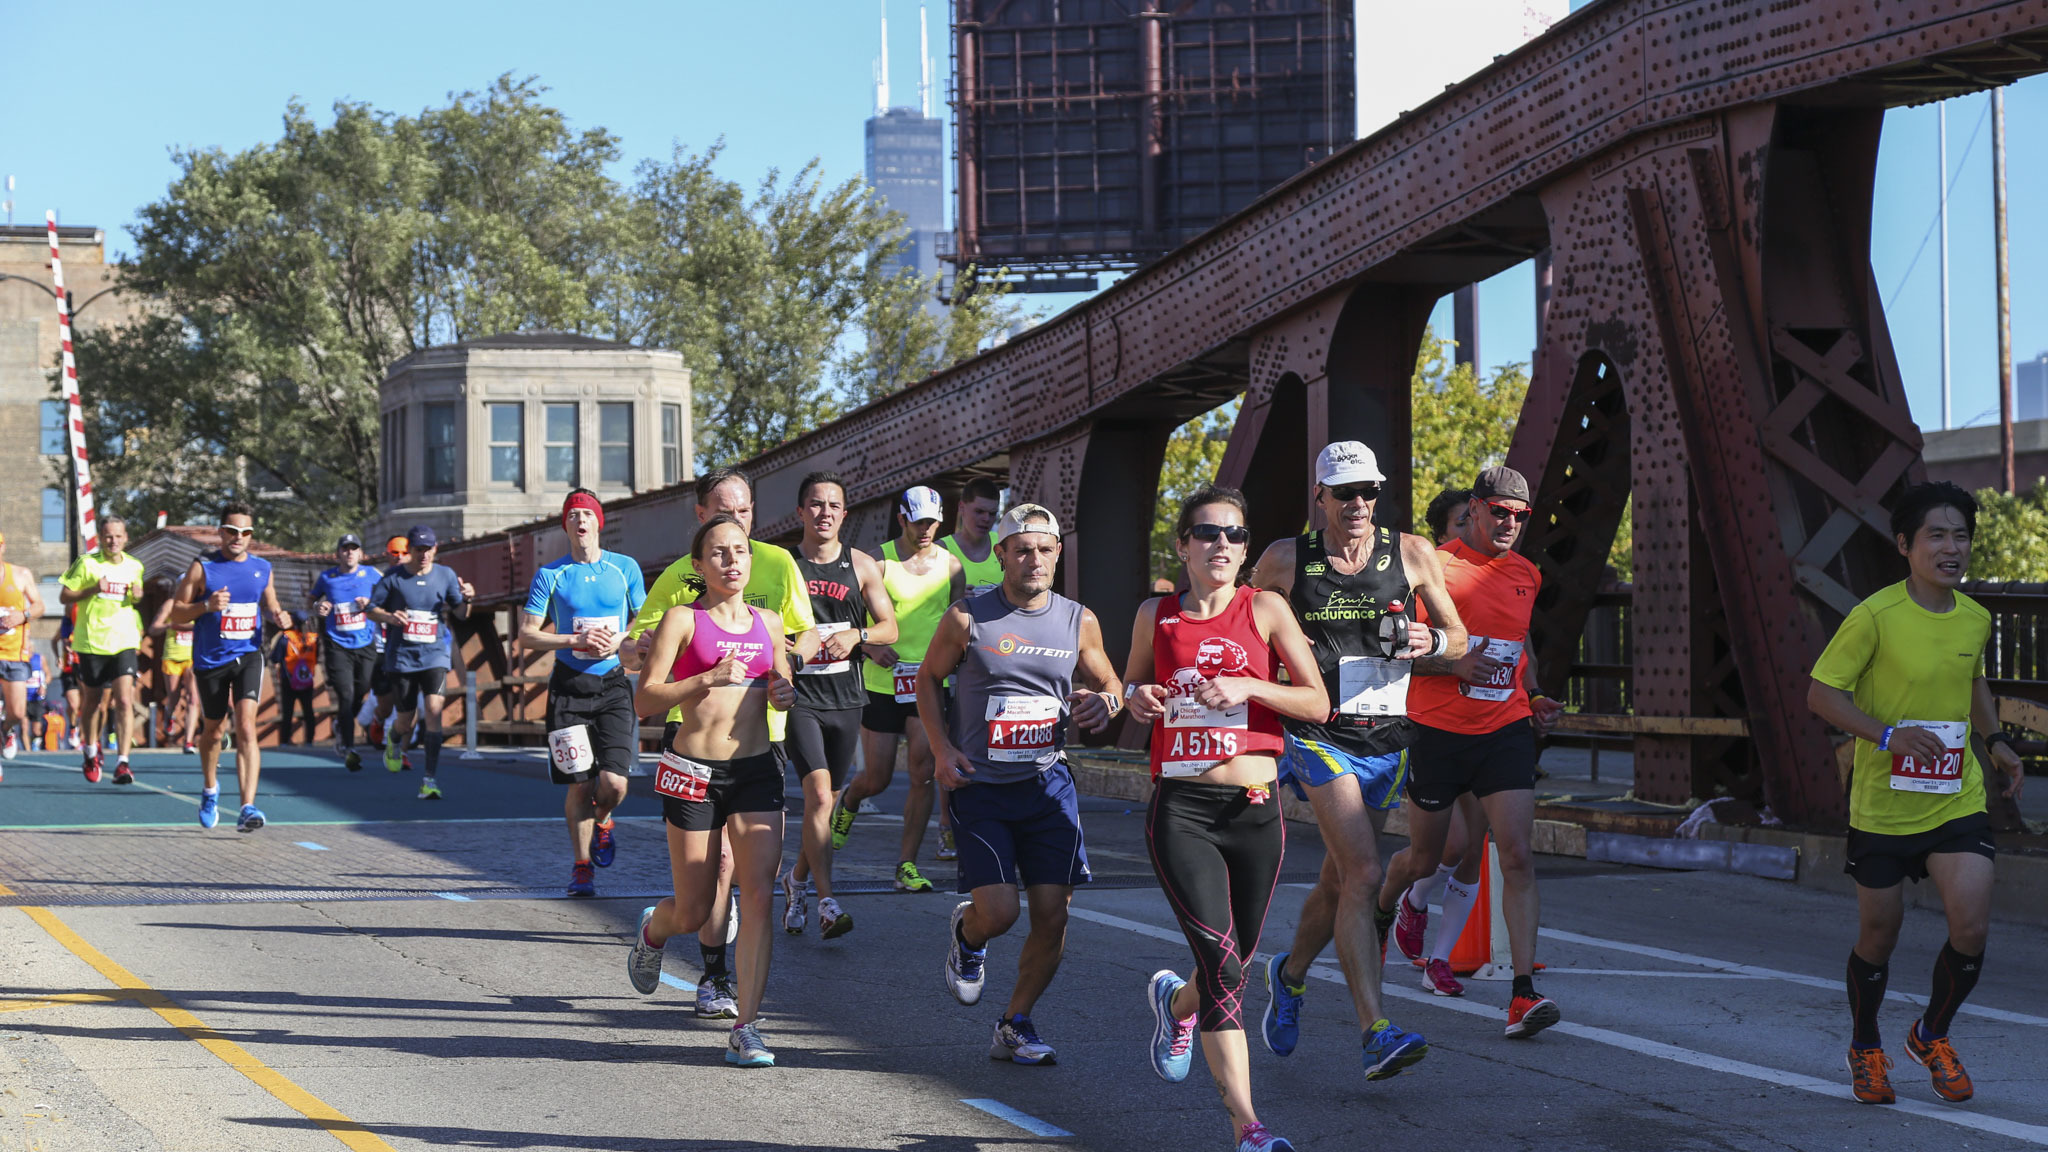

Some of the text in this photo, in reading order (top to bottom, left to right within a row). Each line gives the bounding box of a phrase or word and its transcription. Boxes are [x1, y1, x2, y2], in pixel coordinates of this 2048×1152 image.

[805, 580, 850, 600] STON
[1326, 590, 1376, 609] Equipe
[225, 617, 233, 630] A
[1304, 609, 1376, 621] endurance
[407, 623, 415, 633] A
[719, 648, 763, 663] Rcing
[1016, 645, 1073, 659] INTENT
[1486, 666, 1513, 686] 030
[896, 678, 905, 693] A
[991, 722, 1053, 745] A 12088
[1170, 731, 1237, 757] A 5116
[555, 744, 588, 764] 3:05
[1901, 756, 1915, 773] A
[660, 770, 696, 796] 6071
